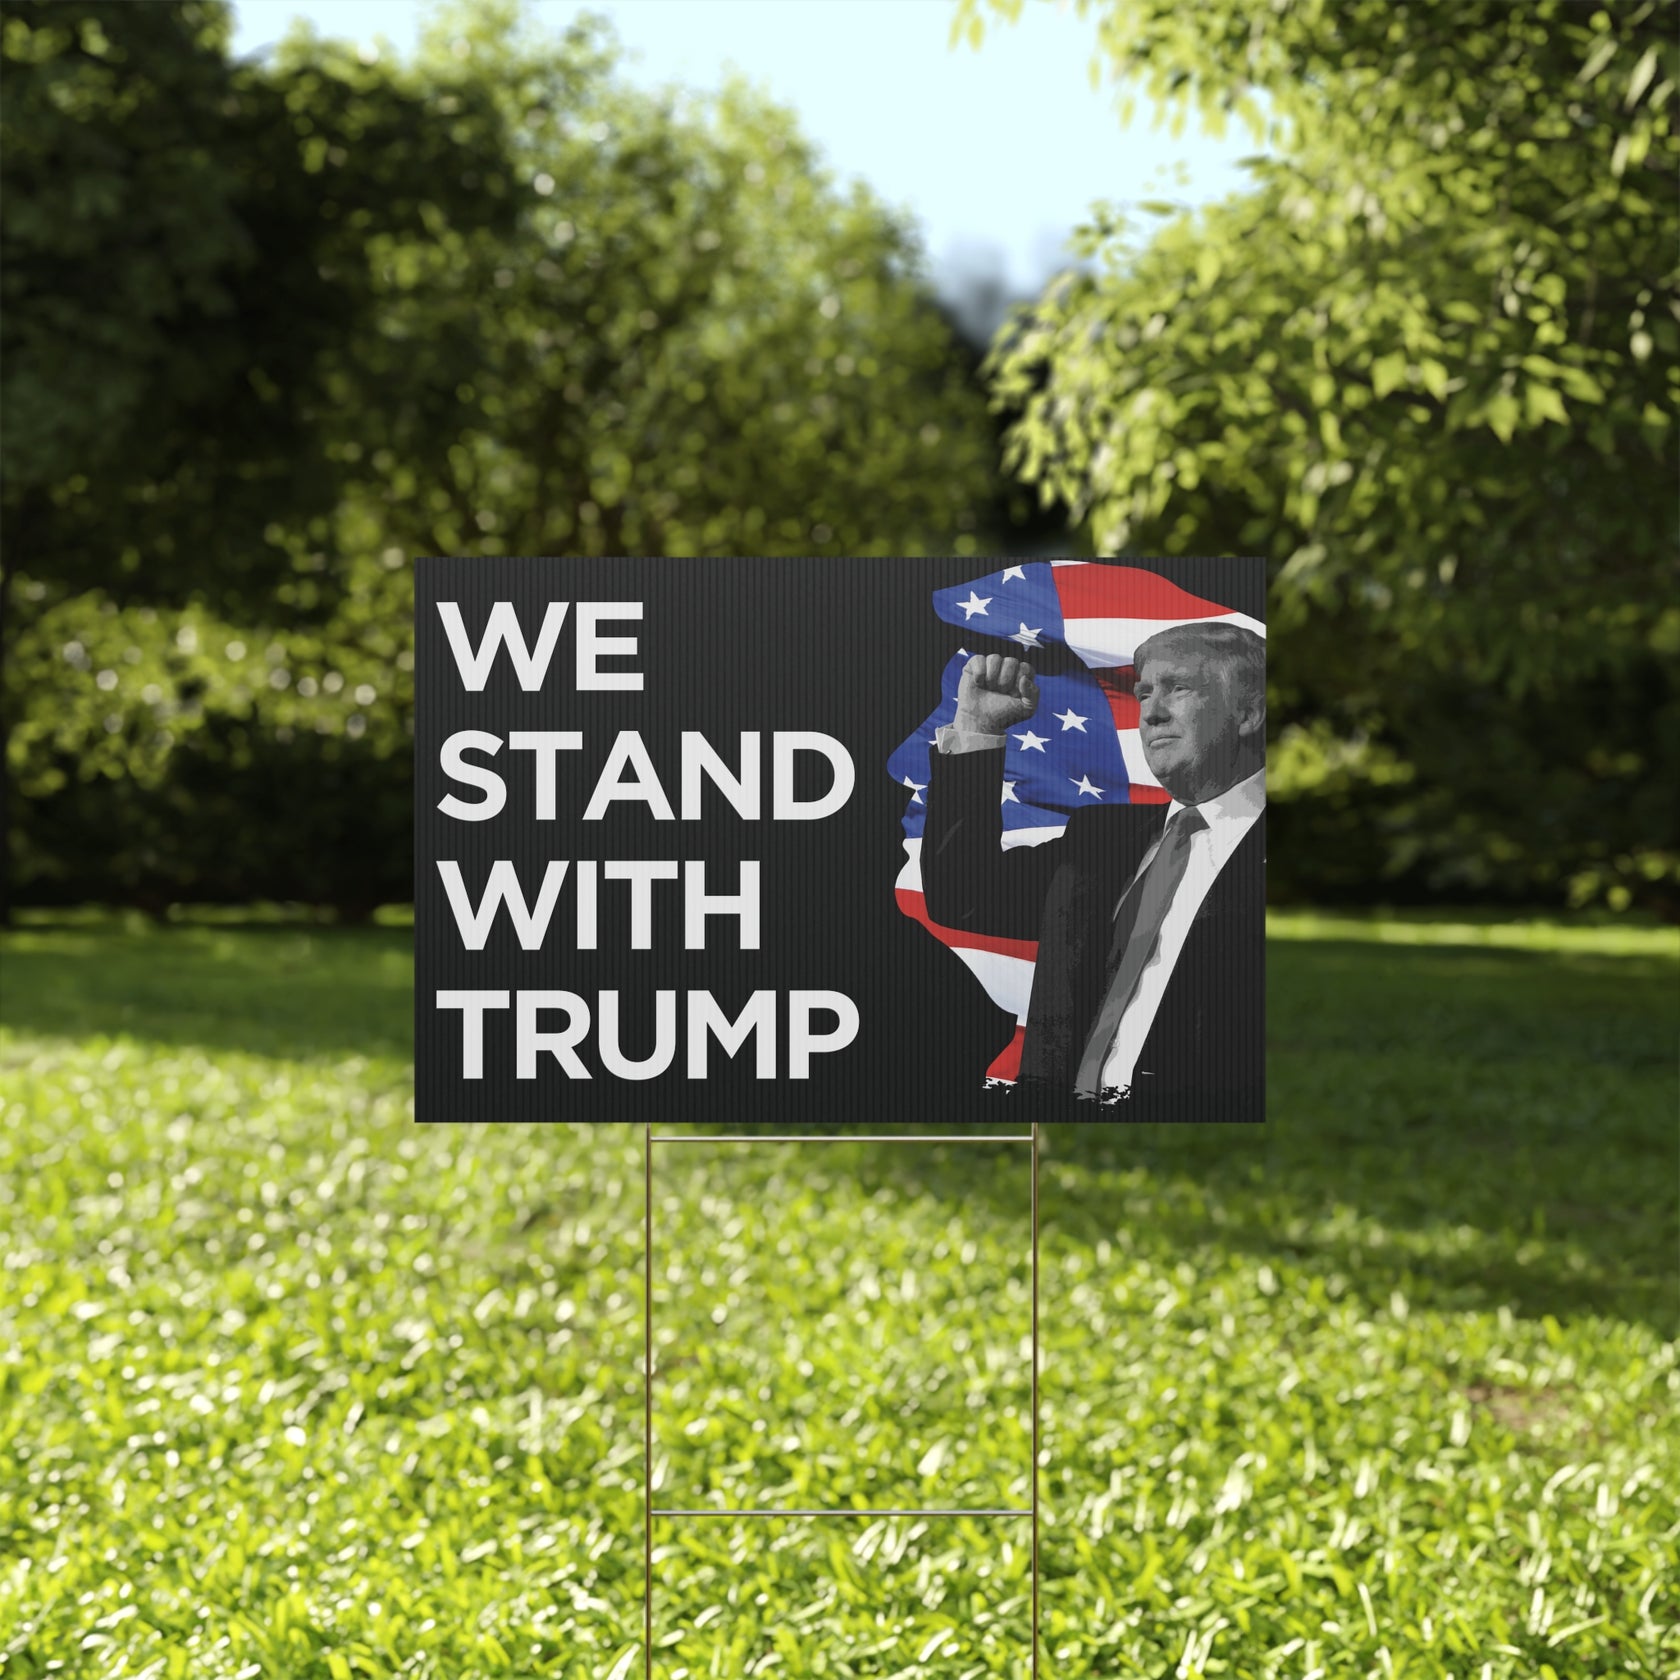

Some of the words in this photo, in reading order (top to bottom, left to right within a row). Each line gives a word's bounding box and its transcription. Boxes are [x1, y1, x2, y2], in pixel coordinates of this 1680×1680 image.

[436, 601, 644, 691] WE
[436, 730, 856, 822] STAND
[436, 860, 761, 950] WITH
[436, 989, 860, 1081] TRUMP
